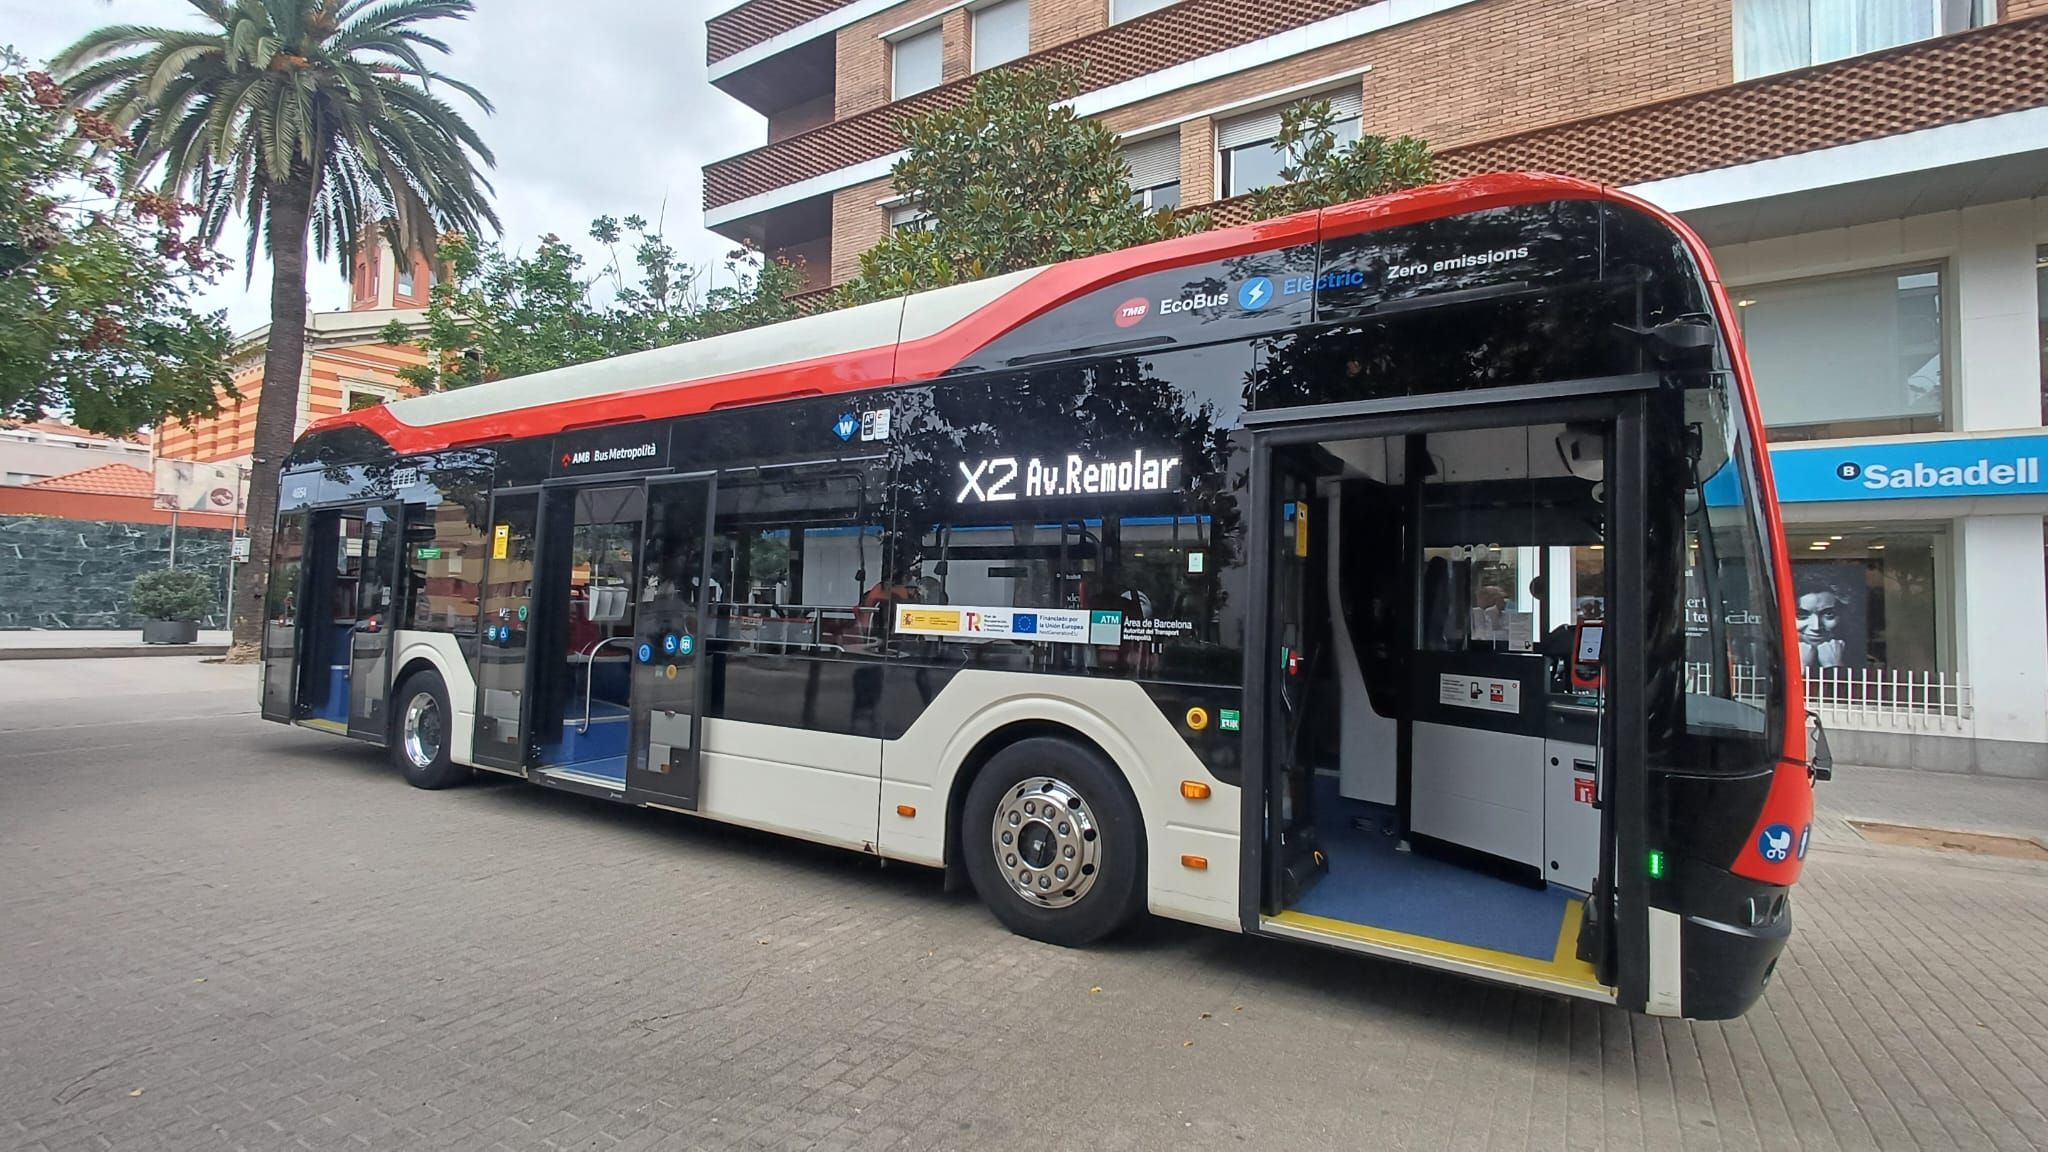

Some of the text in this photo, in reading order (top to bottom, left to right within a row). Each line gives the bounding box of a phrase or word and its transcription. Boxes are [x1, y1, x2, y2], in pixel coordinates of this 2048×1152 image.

[1387, 247, 1529, 279] Zero emissions
[1122, 293, 1229, 317] TMB EcoBus
[572, 443, 656, 464] AMB Bus Metropolità
[956, 457, 1018, 503] X2
[1843, 457, 2039, 489] B Sabadell
[1101, 615, 1119, 625] ATM
[1142, 619, 1152, 628] de
[1153, 618, 1193, 630] Barcelona
[1155, 628, 1179, 637] Transport
